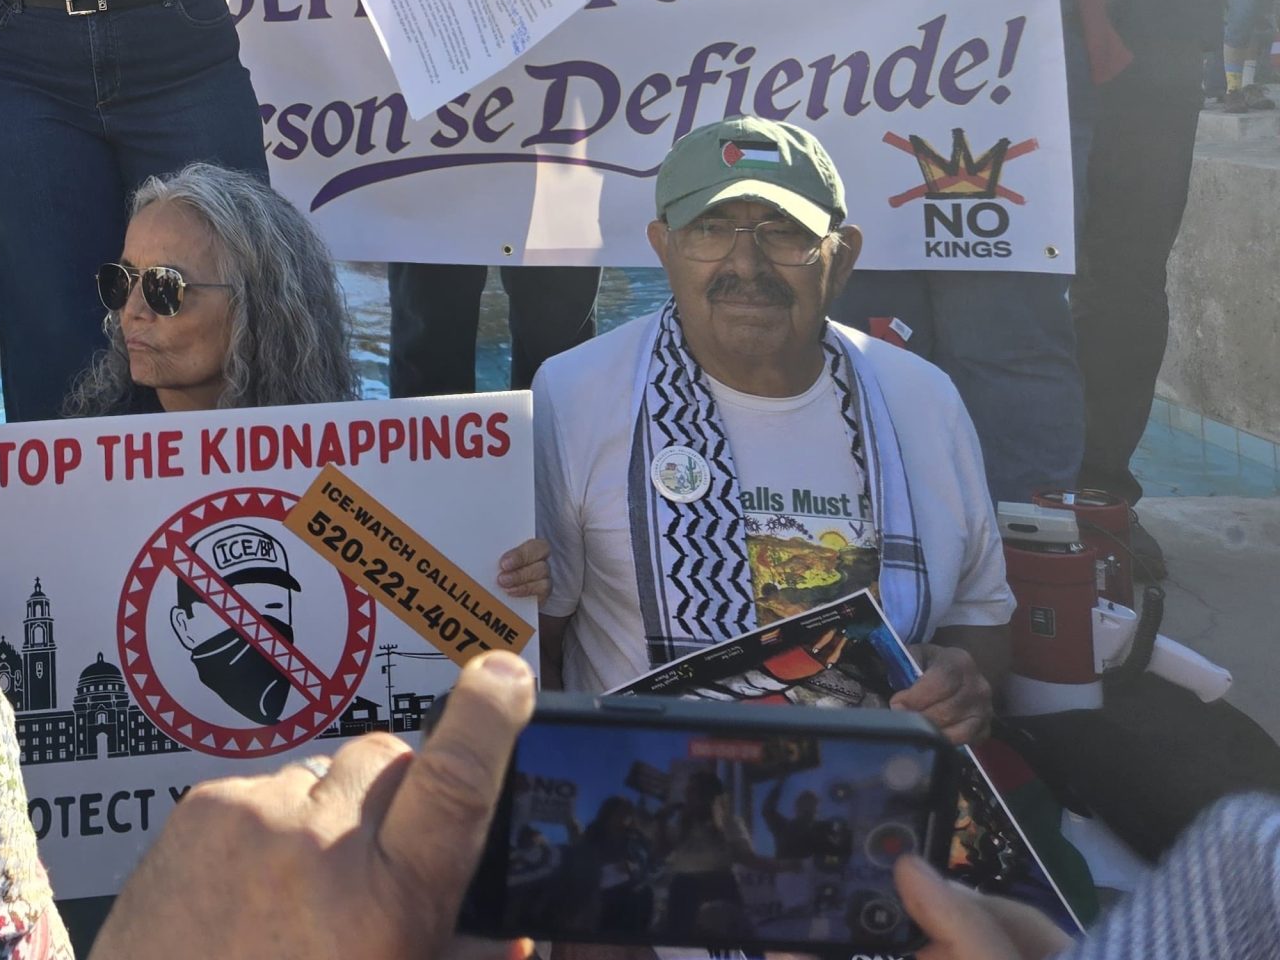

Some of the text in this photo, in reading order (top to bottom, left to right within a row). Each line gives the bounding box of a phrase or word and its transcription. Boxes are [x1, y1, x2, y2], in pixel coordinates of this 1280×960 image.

[430, 86, 516, 148] se
[521, 13, 1027, 148] Defiende!
[924, 202, 1010, 239] NO
[924, 240, 1013, 258] KINGS
[96, 430, 185, 481] THE
[200, 411, 512, 476] KIDNAPPINGS
[740, 486, 785, 512] alls
[792, 488, 852, 517] Must
[216, 538, 274, 565] ICE/BP
[321, 481, 519, 646] ICE-WATCH CALL/LLAME
[28, 788, 156, 841] OTECT
